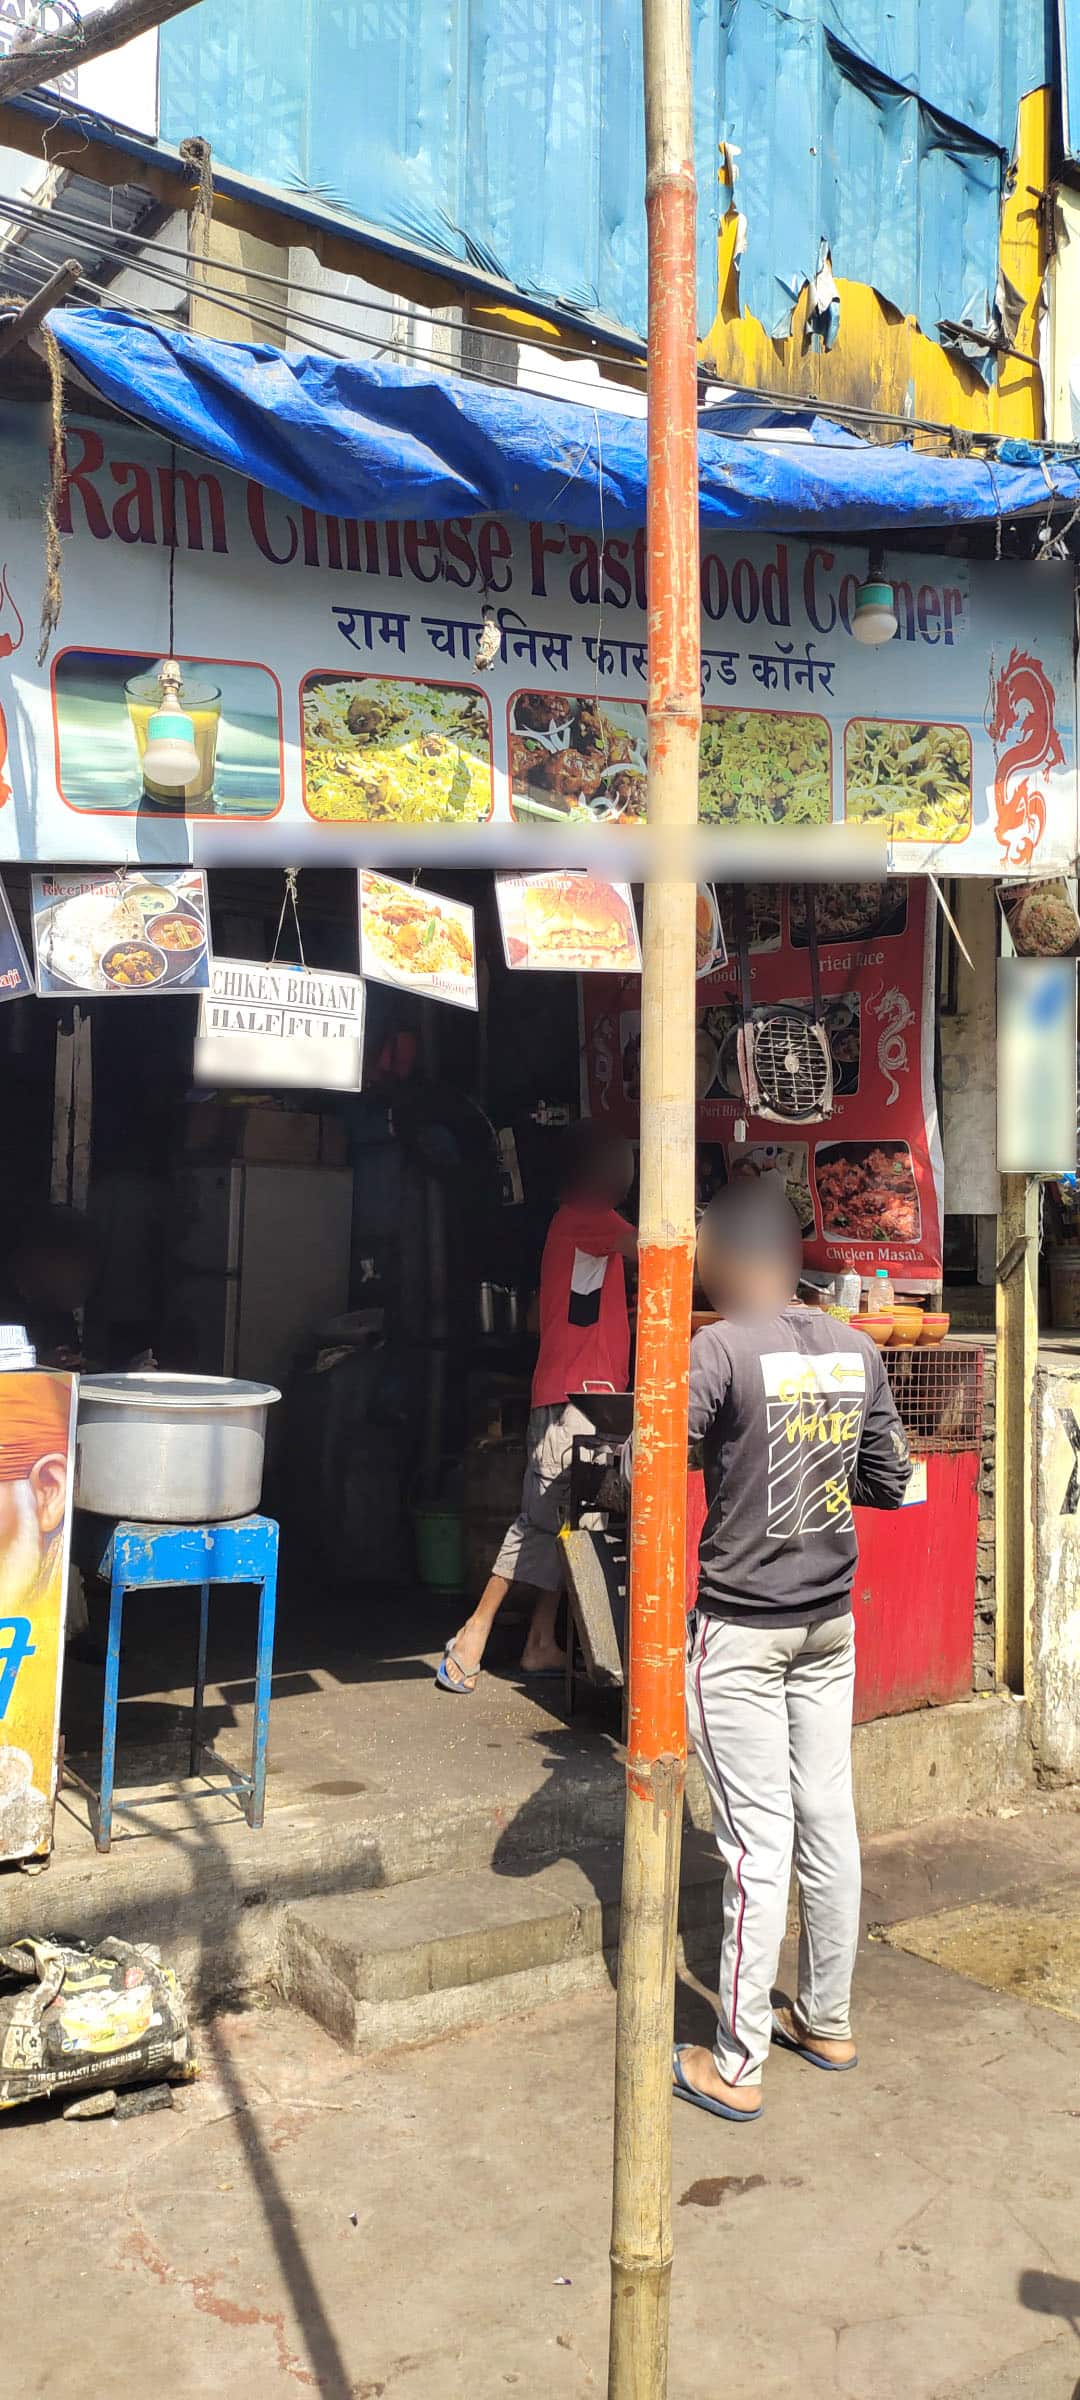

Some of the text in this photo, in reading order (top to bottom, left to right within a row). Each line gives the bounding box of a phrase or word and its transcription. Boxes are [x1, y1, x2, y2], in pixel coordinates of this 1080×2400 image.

[48, 427, 229, 554] Ram
[698, 543, 792, 627] ood
[804, 547, 963, 646] Coner
[331, 606, 410, 653] राम
[748, 641, 835, 697] कॉर्नर
[704, 964, 757, 985] Noodls
[818, 953, 852, 973] ried
[213, 970, 357, 1011] CHIKEN BIRYANI
[211, 1008, 280, 1032] HALF
[826, 1247, 924, 1261] Chicken Masala
[91, 2050, 142, 2074] ENTERPRISES
